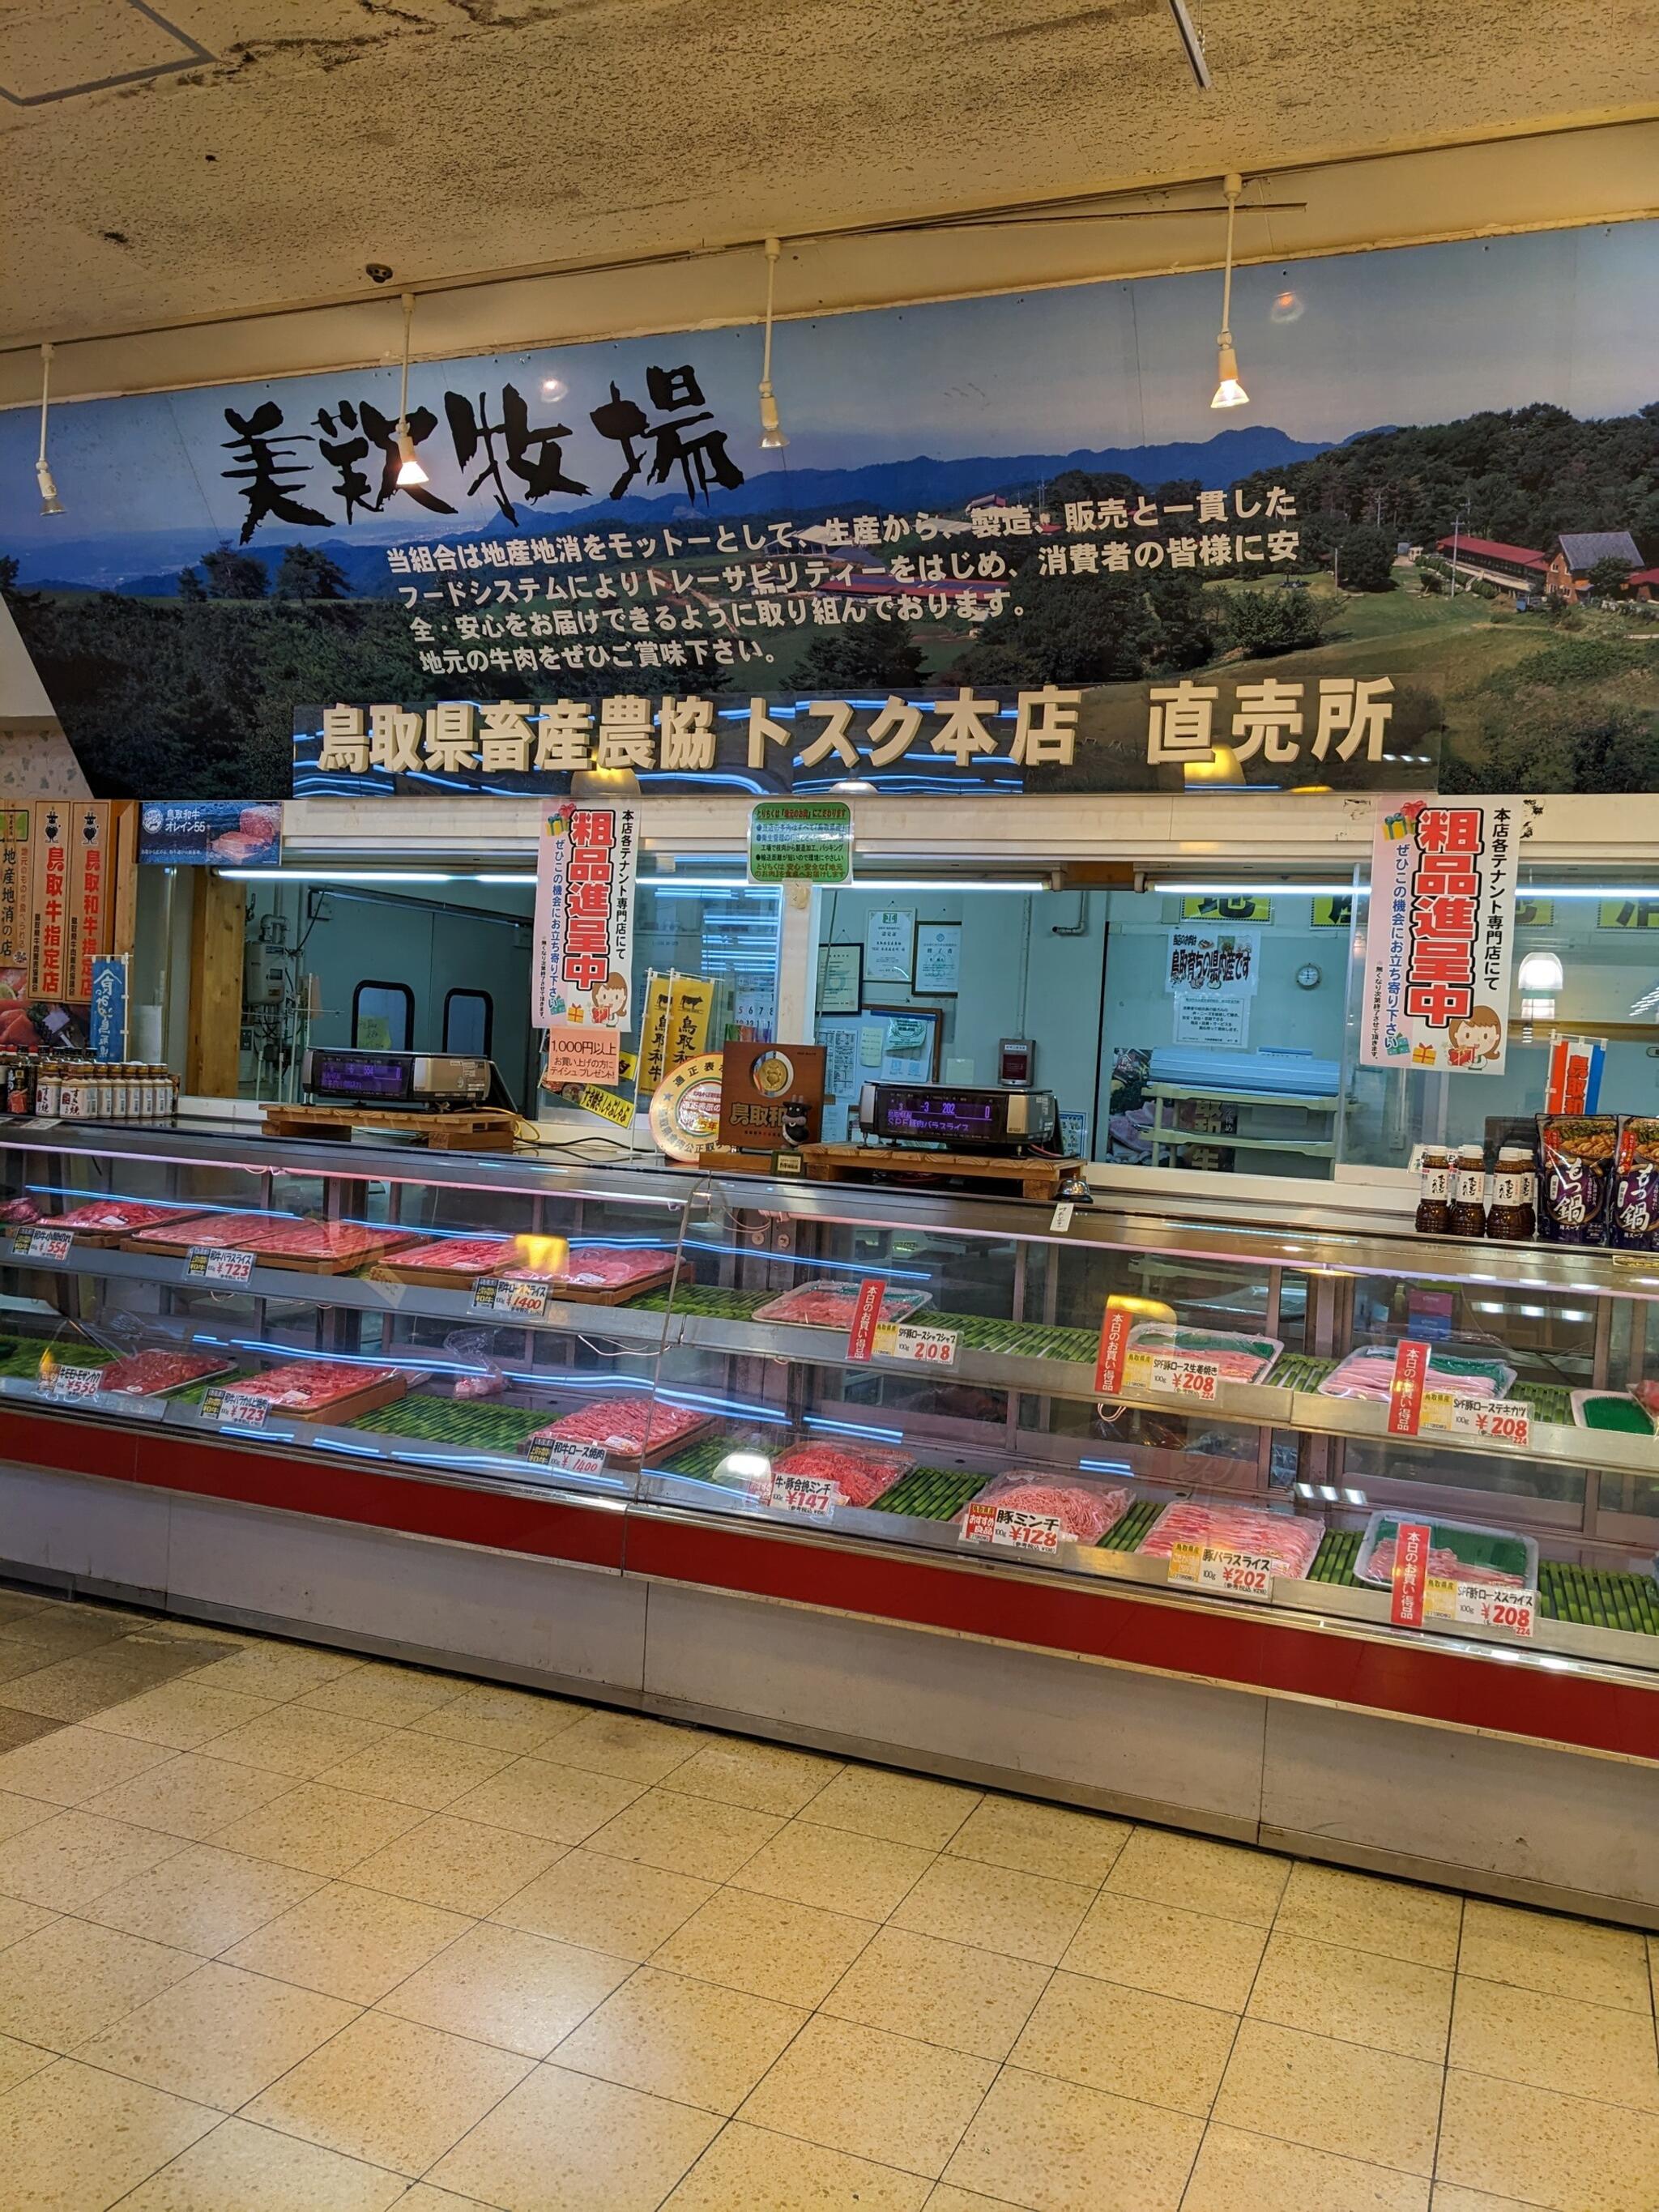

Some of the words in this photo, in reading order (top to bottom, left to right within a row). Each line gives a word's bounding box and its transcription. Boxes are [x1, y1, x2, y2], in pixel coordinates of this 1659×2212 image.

[399, 529, 1299, 610] フードシステムによりトレーサビリティーをはじめ、消費者の皆様に安
[410, 590, 1025, 644] 全・安心をお届けできるように取り組んでおります。
[420, 637, 776, 676] 地元の牛肉をぜひご賞味下さい。
[1146, 676, 1397, 764] 直売所
[165, 809, 201, 820] 鳥取和牛
[165, 821, 207, 833] オレイン55
[616, 810, 635, 960] 本店各テナント専門店にて
[0, 848, 17, 957] 地産地消の店
[562, 809, 616, 991] 粗品進呈中
[1484, 808, 1511, 991] 本店各テナント専門店にて
[42, 846, 65, 994] 鳥取牛指定店
[548, 839, 565, 1008] ぜひこの機会にお立ち寄り下さい
[1405, 808, 1484, 1028] 粗品進呈中
[1384, 844, 1410, 1049] ぜひこの機会にお立ち寄り下さい
[738, 1006, 744, 1014] 5
[748, 1006, 753, 1015] 6
[759, 1006, 764, 1015] 7
[551, 1040, 617, 1056] 1,000円以上
[554, 1056, 614, 1069] お買い上げの方に
[942, 1103, 956, 1115] 202
[985, 1106, 990, 1119] 0
[1553, 1157, 1586, 1224] もつ鍋
[1619, 1163, 1654, 1231] もつ鍋
[211, 1250, 252, 1264] 和牛バラスライス
[855, 1285, 879, 1360] 本日のお買い得品
[914, 1341, 951, 1361] 208
[1102, 1314, 1124, 1392] 本日のお買い得品
[1128, 1353, 1151, 1364] 鳥取県産
[1154, 1359, 1218, 1377] SPF豚ロース生姜焼き
[1171, 1373, 1215, 1392] ¥208
[1424, 1394, 1450, 1403] 鳥取県産
[554, 1442, 606, 1461] 和牛ロース焼肉
[1513, 1437, 1528, 1445] 224
[785, 1490, 830, 1511] ¥147
[969, 1514, 995, 1528] おすすめ
[974, 1525, 993, 1536] 良品
[996, 1509, 1060, 1531] 豚ミンチ
[1009, 1525, 1057, 1547] ¥128
[1202, 1549, 1271, 1571] 豚バラスライス
[1222, 1566, 1266, 1588] ¥202
[1401, 1532, 1421, 1620] 本日のお買い得品
[1427, 1579, 1454, 1590] 鳥取県産
[1481, 1602, 1530, 1627] ¥208
[1516, 1627, 1531, 1636] 224
